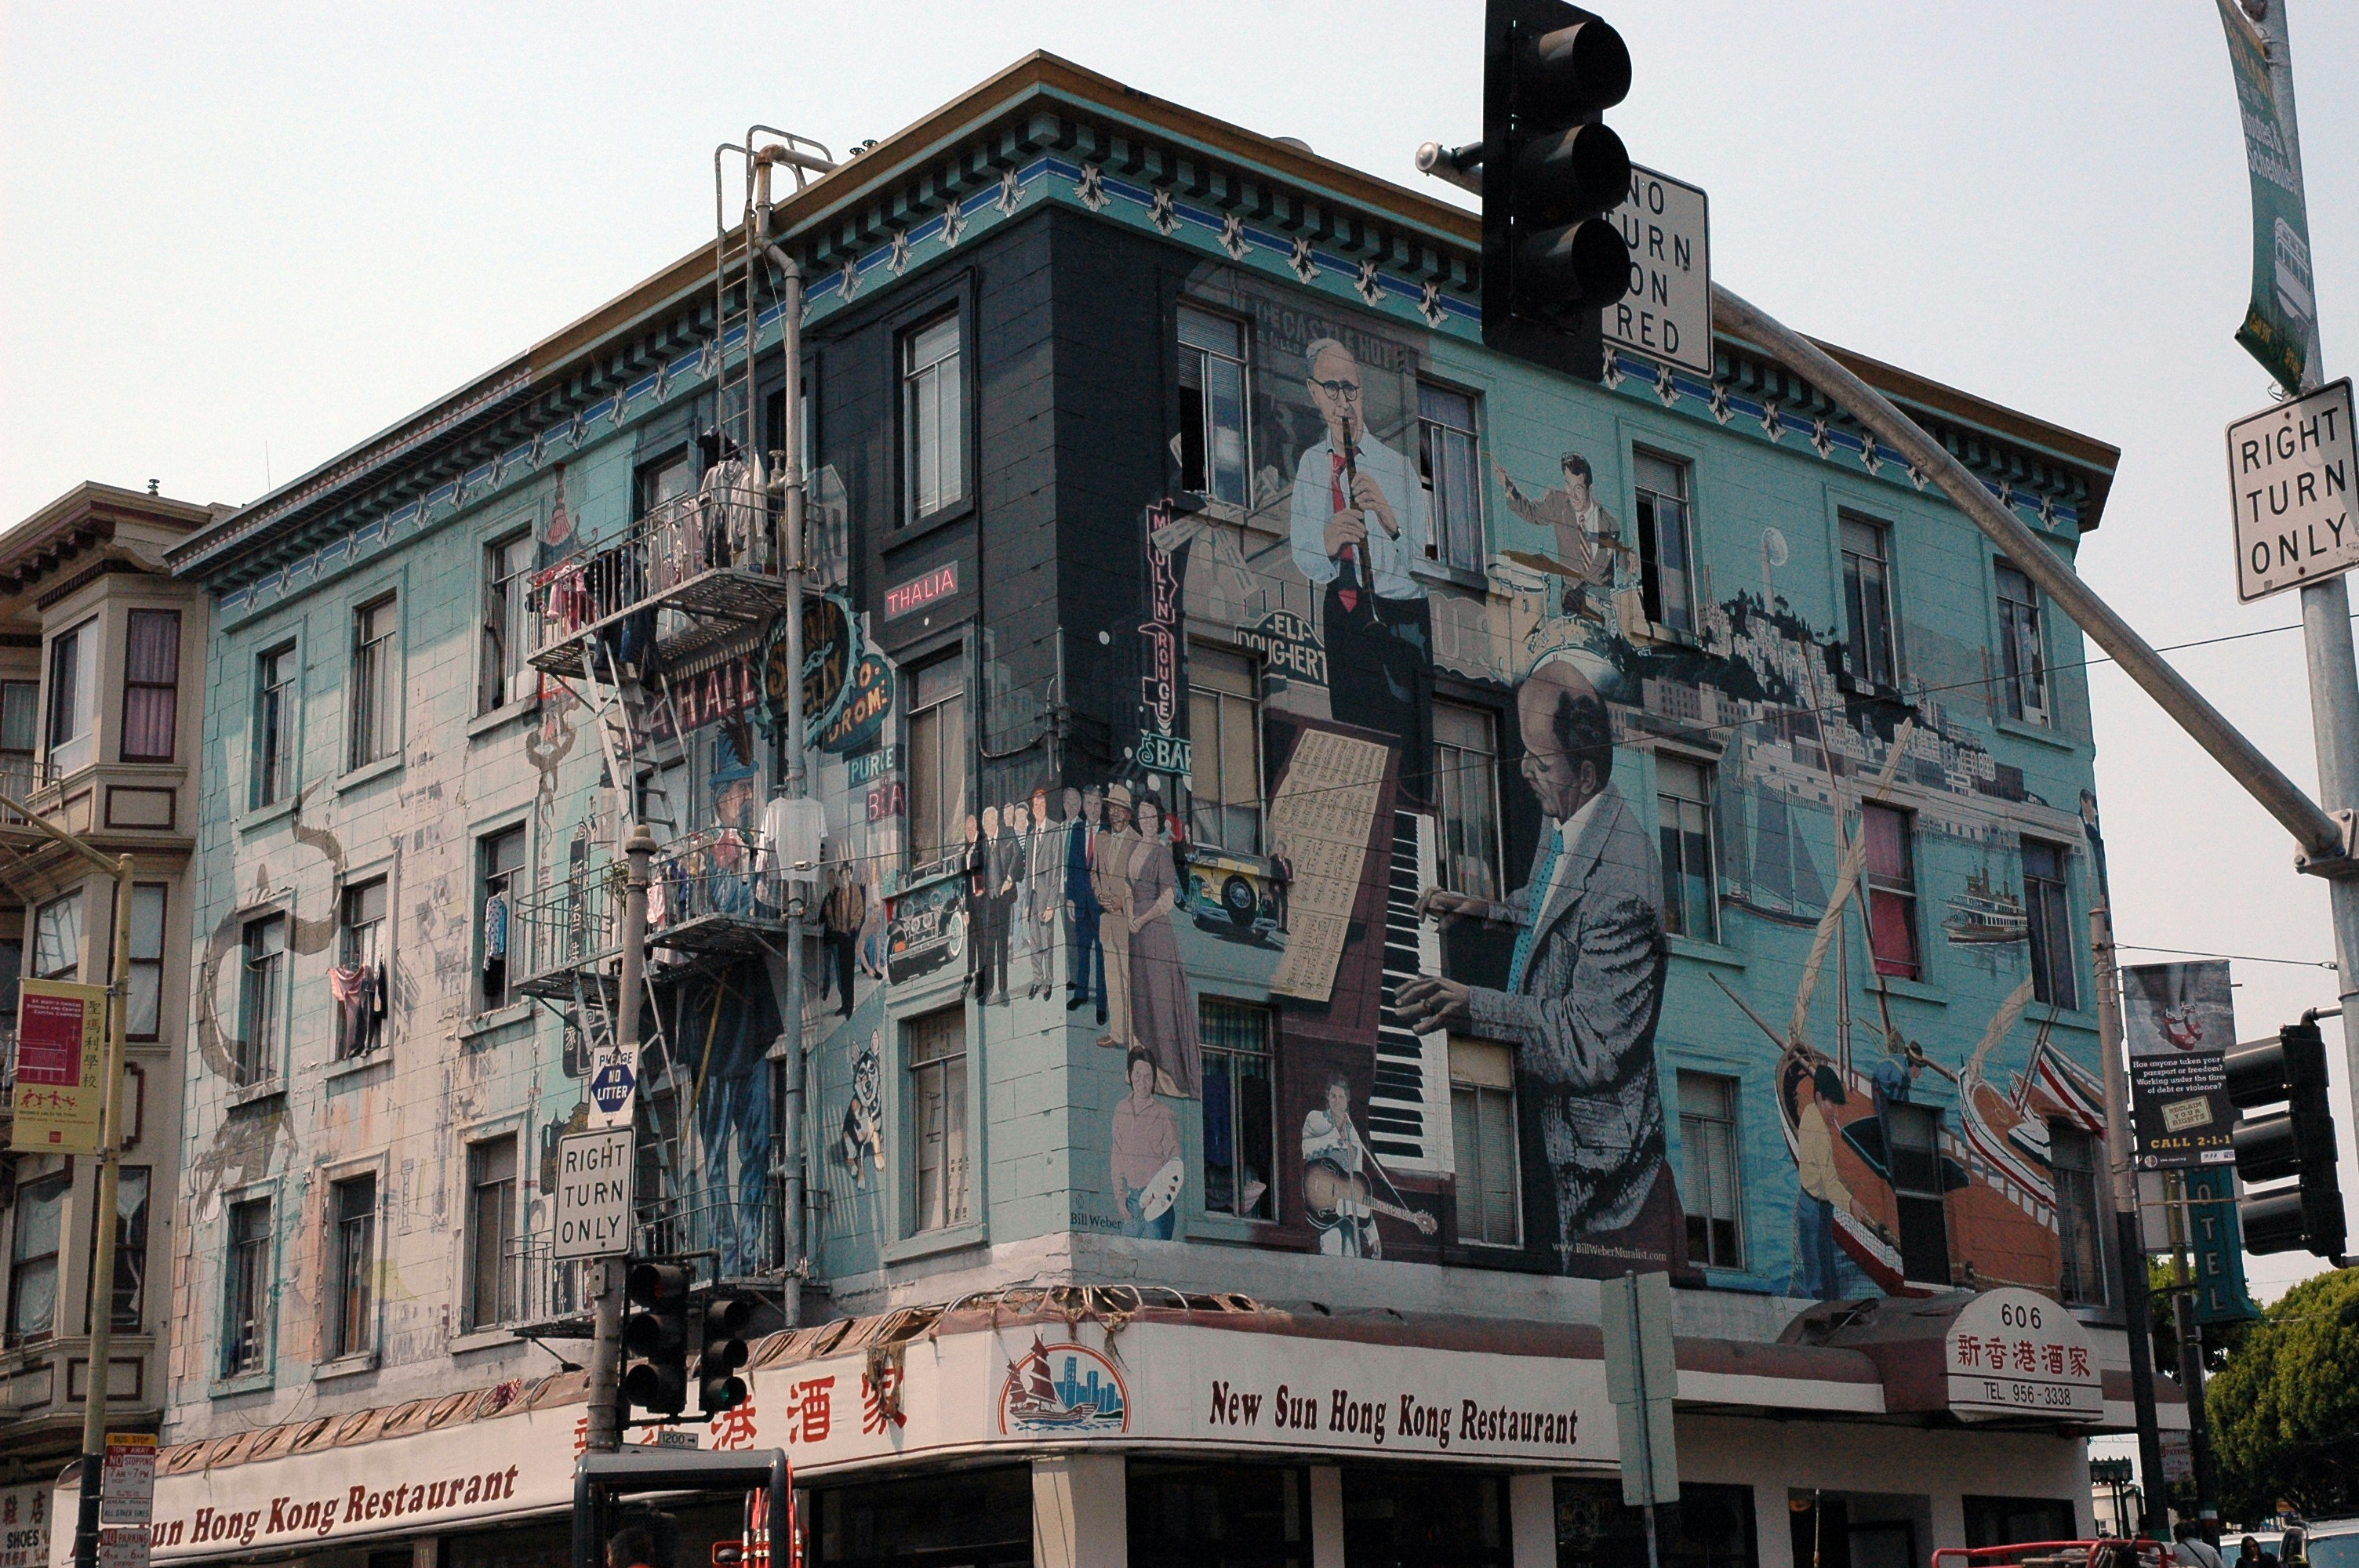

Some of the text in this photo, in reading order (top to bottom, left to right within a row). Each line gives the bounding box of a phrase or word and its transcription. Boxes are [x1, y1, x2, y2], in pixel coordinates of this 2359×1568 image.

[1627, 174, 1665, 216] NO
[1629, 261, 1668, 307] ON
[1616, 302, 1680, 354] RED
[2241, 407, 2341, 474] RIGHT
[2245, 459, 2347, 524] TURN
[2251, 512, 2349, 575] ONLY
[1153, 514, 1170, 619] MULIN
[887, 568, 956, 615] THALIA
[1158, 632, 1171, 718] ROUGE
[598, 1052, 633, 1066] PLEASE
[2143, 1069, 2176, 1077] passport
[2187, 1065, 2223, 1073] freedom?
[2150, 1060, 2178, 1069] anyone
[609, 1069, 620, 1083] NO
[2186, 1082, 2222, 1091] violence?
[597, 1085, 628, 1101] LITTER
[2169, 1102, 2202, 1114] RECLAIM
[2172, 1113, 2205, 1126] RIGHTS
[2174, 1109, 2201, 1119] YOUR
[2150, 1134, 2231, 1149] CALL 2-1-1
[565, 1144, 626, 1174] RIGHT
[564, 1179, 624, 1208] TURN
[562, 1214, 621, 1244] ONLY
[1070, 1212, 1121, 1229] Bill Weber
[1551, 1243, 1667, 1261] www.BillWeberMuralist.com
[2195, 1167, 2225, 1312] OTEL
[2001, 1302, 2042, 1330] 606
[1957, 1335, 2091, 1378] 新香港酒家
[1983, 1381, 2006, 1402] TEL.
[573, 1374, 907, 1461] 港酒家
[1209, 1380, 1579, 1449] New Sun Hong Kong Restaurant
[662, 1433, 685, 1444] 1200
[109, 1455, 154, 1466] NO STOPPING
[189, 1506, 261, 1545] Hong
[266, 1494, 337, 1535] Kong
[343, 1464, 520, 1524] Restaurant
[6, 1529, 39, 1549] SHOES
[102, 1530, 148, 1544] NO PARKING
